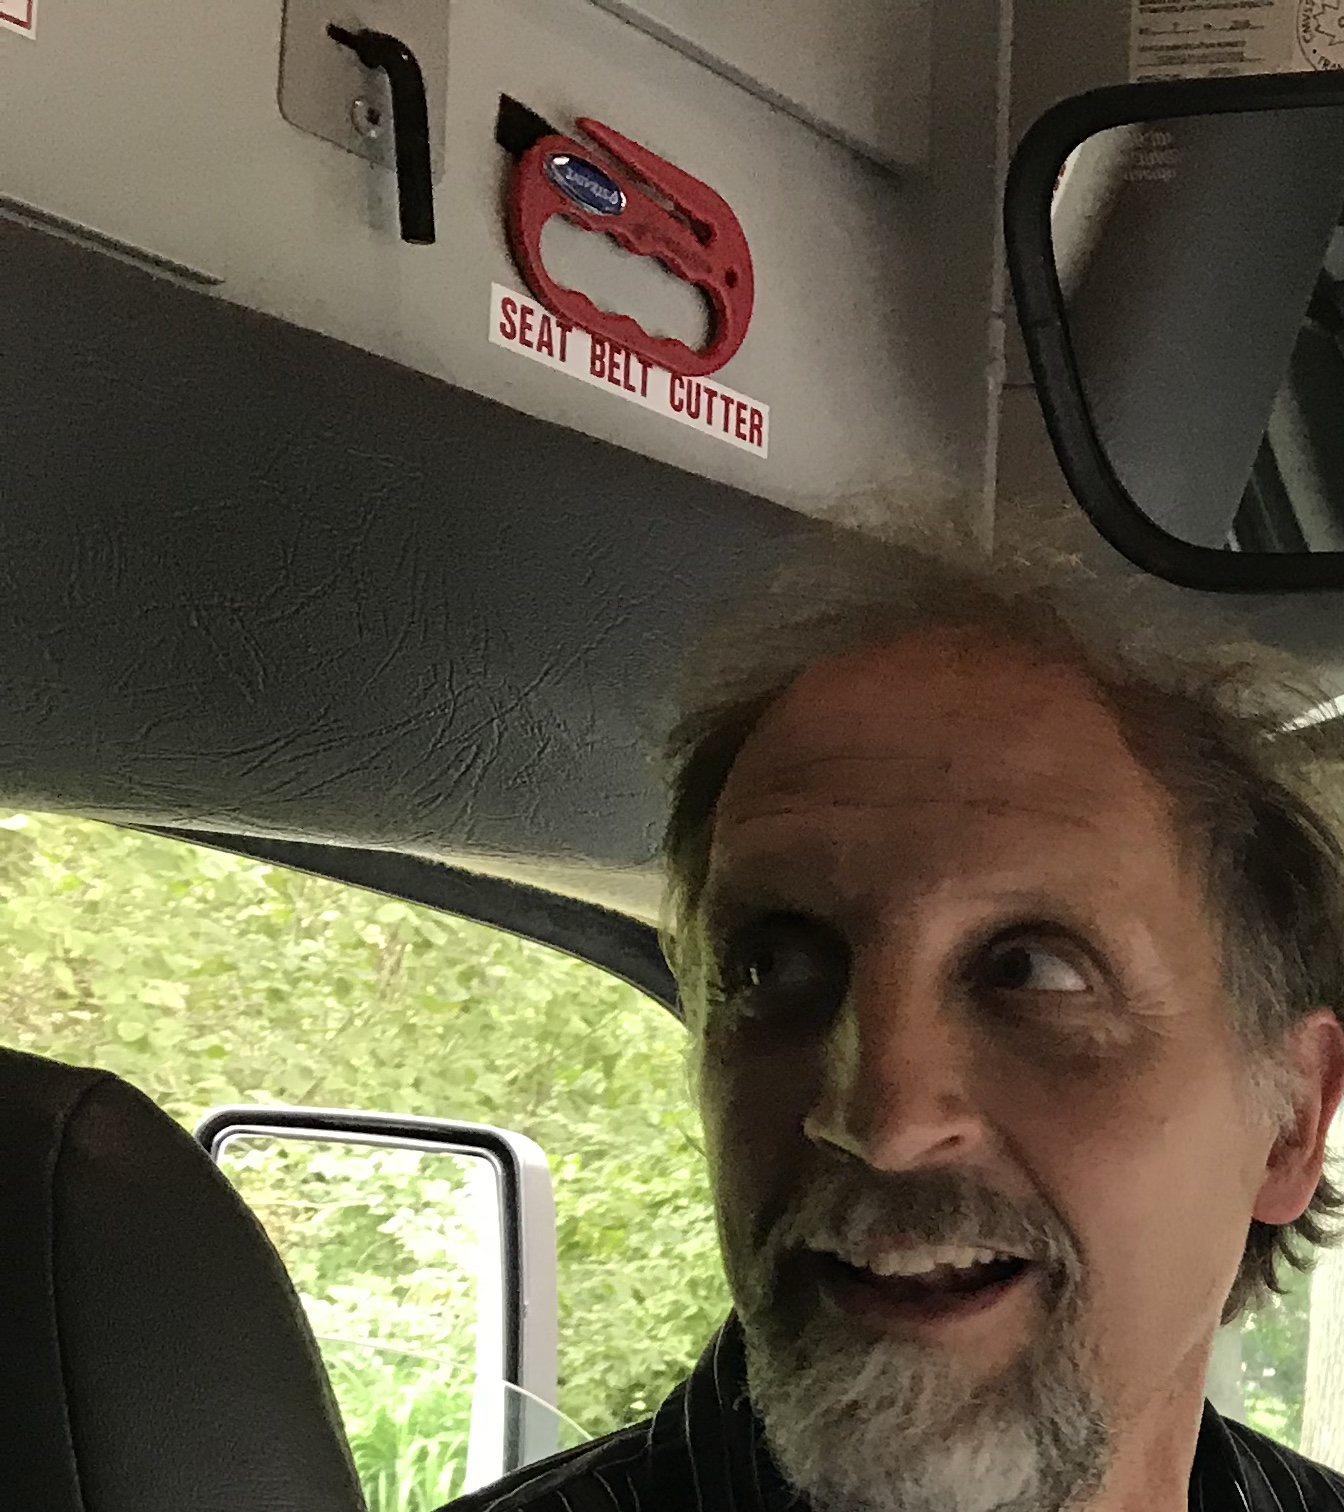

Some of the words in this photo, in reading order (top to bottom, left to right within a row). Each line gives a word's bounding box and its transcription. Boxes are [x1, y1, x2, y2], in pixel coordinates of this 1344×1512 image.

[500, 297, 573, 362] SEAT
[589, 333, 654, 397] BELT
[670, 371, 763, 448] CUTTER
